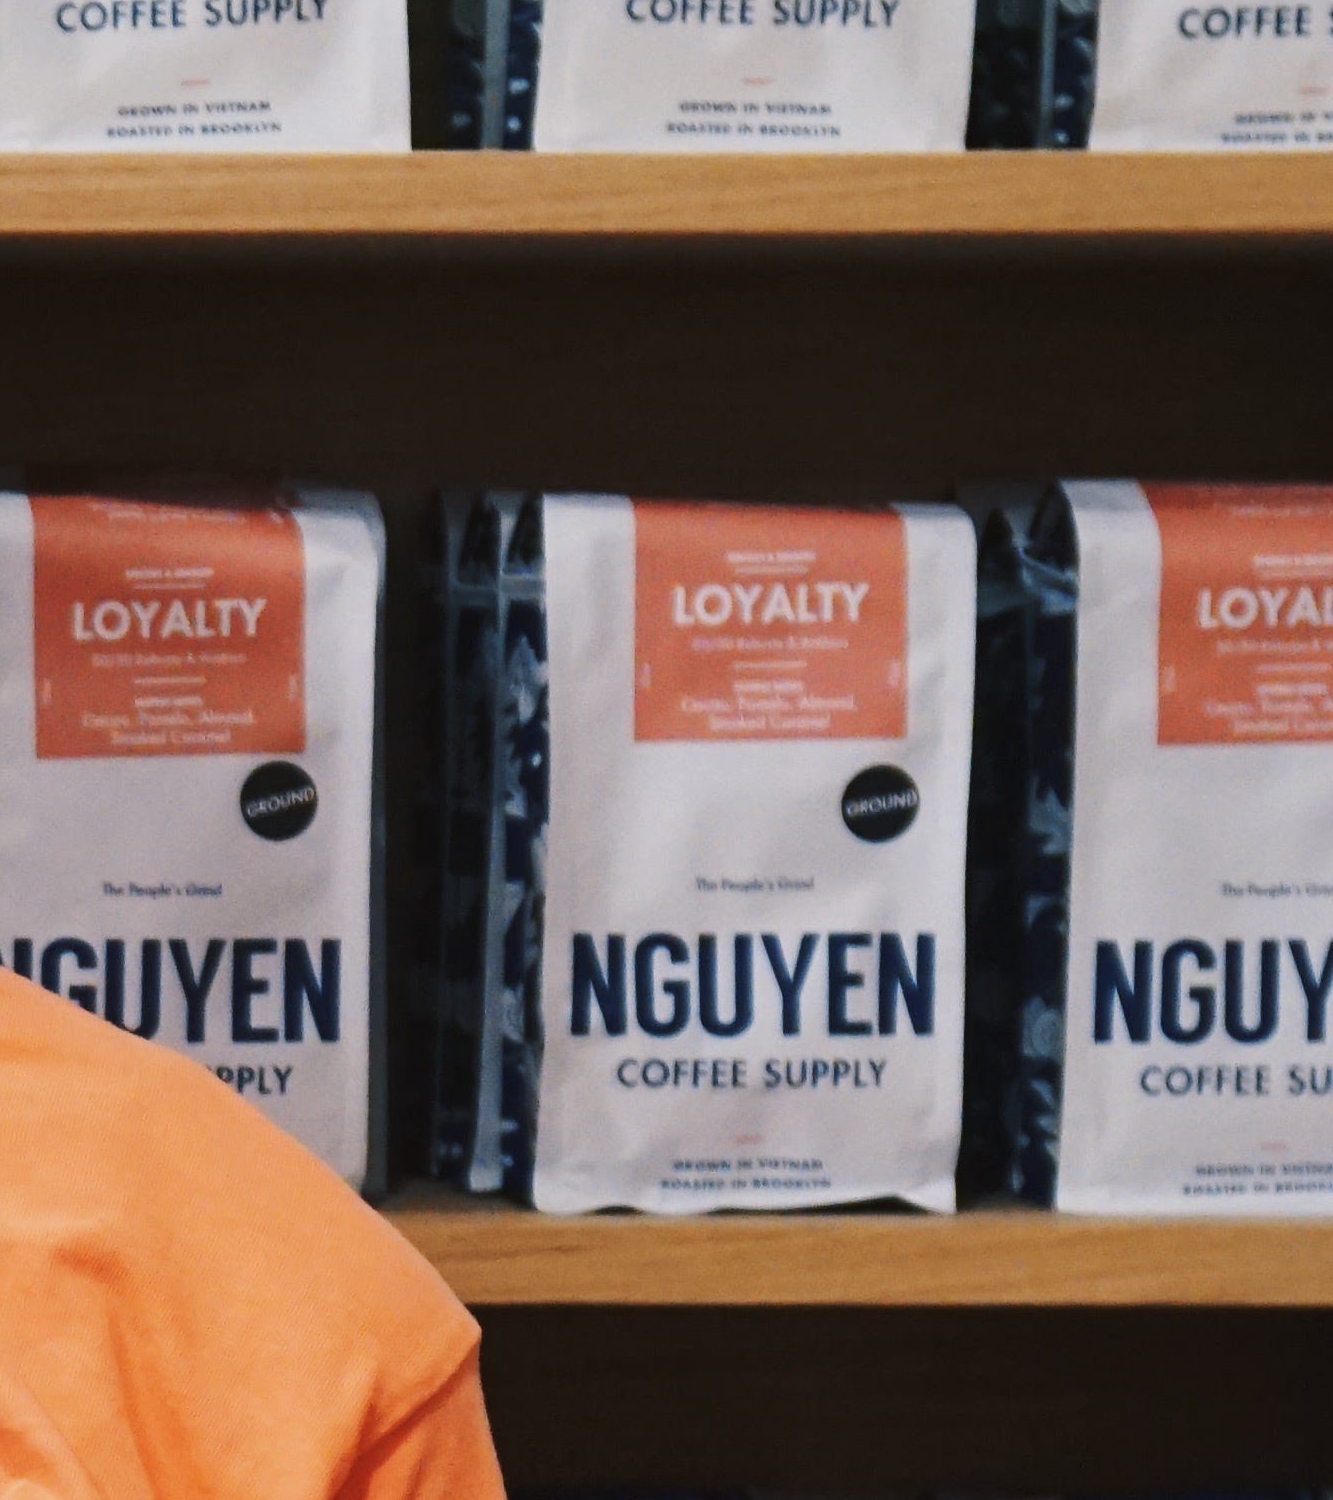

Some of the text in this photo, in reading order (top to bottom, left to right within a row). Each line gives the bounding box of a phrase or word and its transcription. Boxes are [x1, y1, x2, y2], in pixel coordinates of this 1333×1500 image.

[1178, 5, 1312, 40] COFFEE
[71, 597, 268, 642] LOYALTY
[670, 581, 870, 627] LOYALTY
[1196, 585, 1333, 631] LOYA
[247, 787, 316, 818] GROUND
[846, 791, 918, 817] GROUND
[570, 931, 937, 1038] NGUYEN
[1093, 938, 1333, 1045] NGUY
[616, 1058, 888, 1089] COFFEE SUPPLY
[1140, 1064, 1271, 1097] COFFEE
